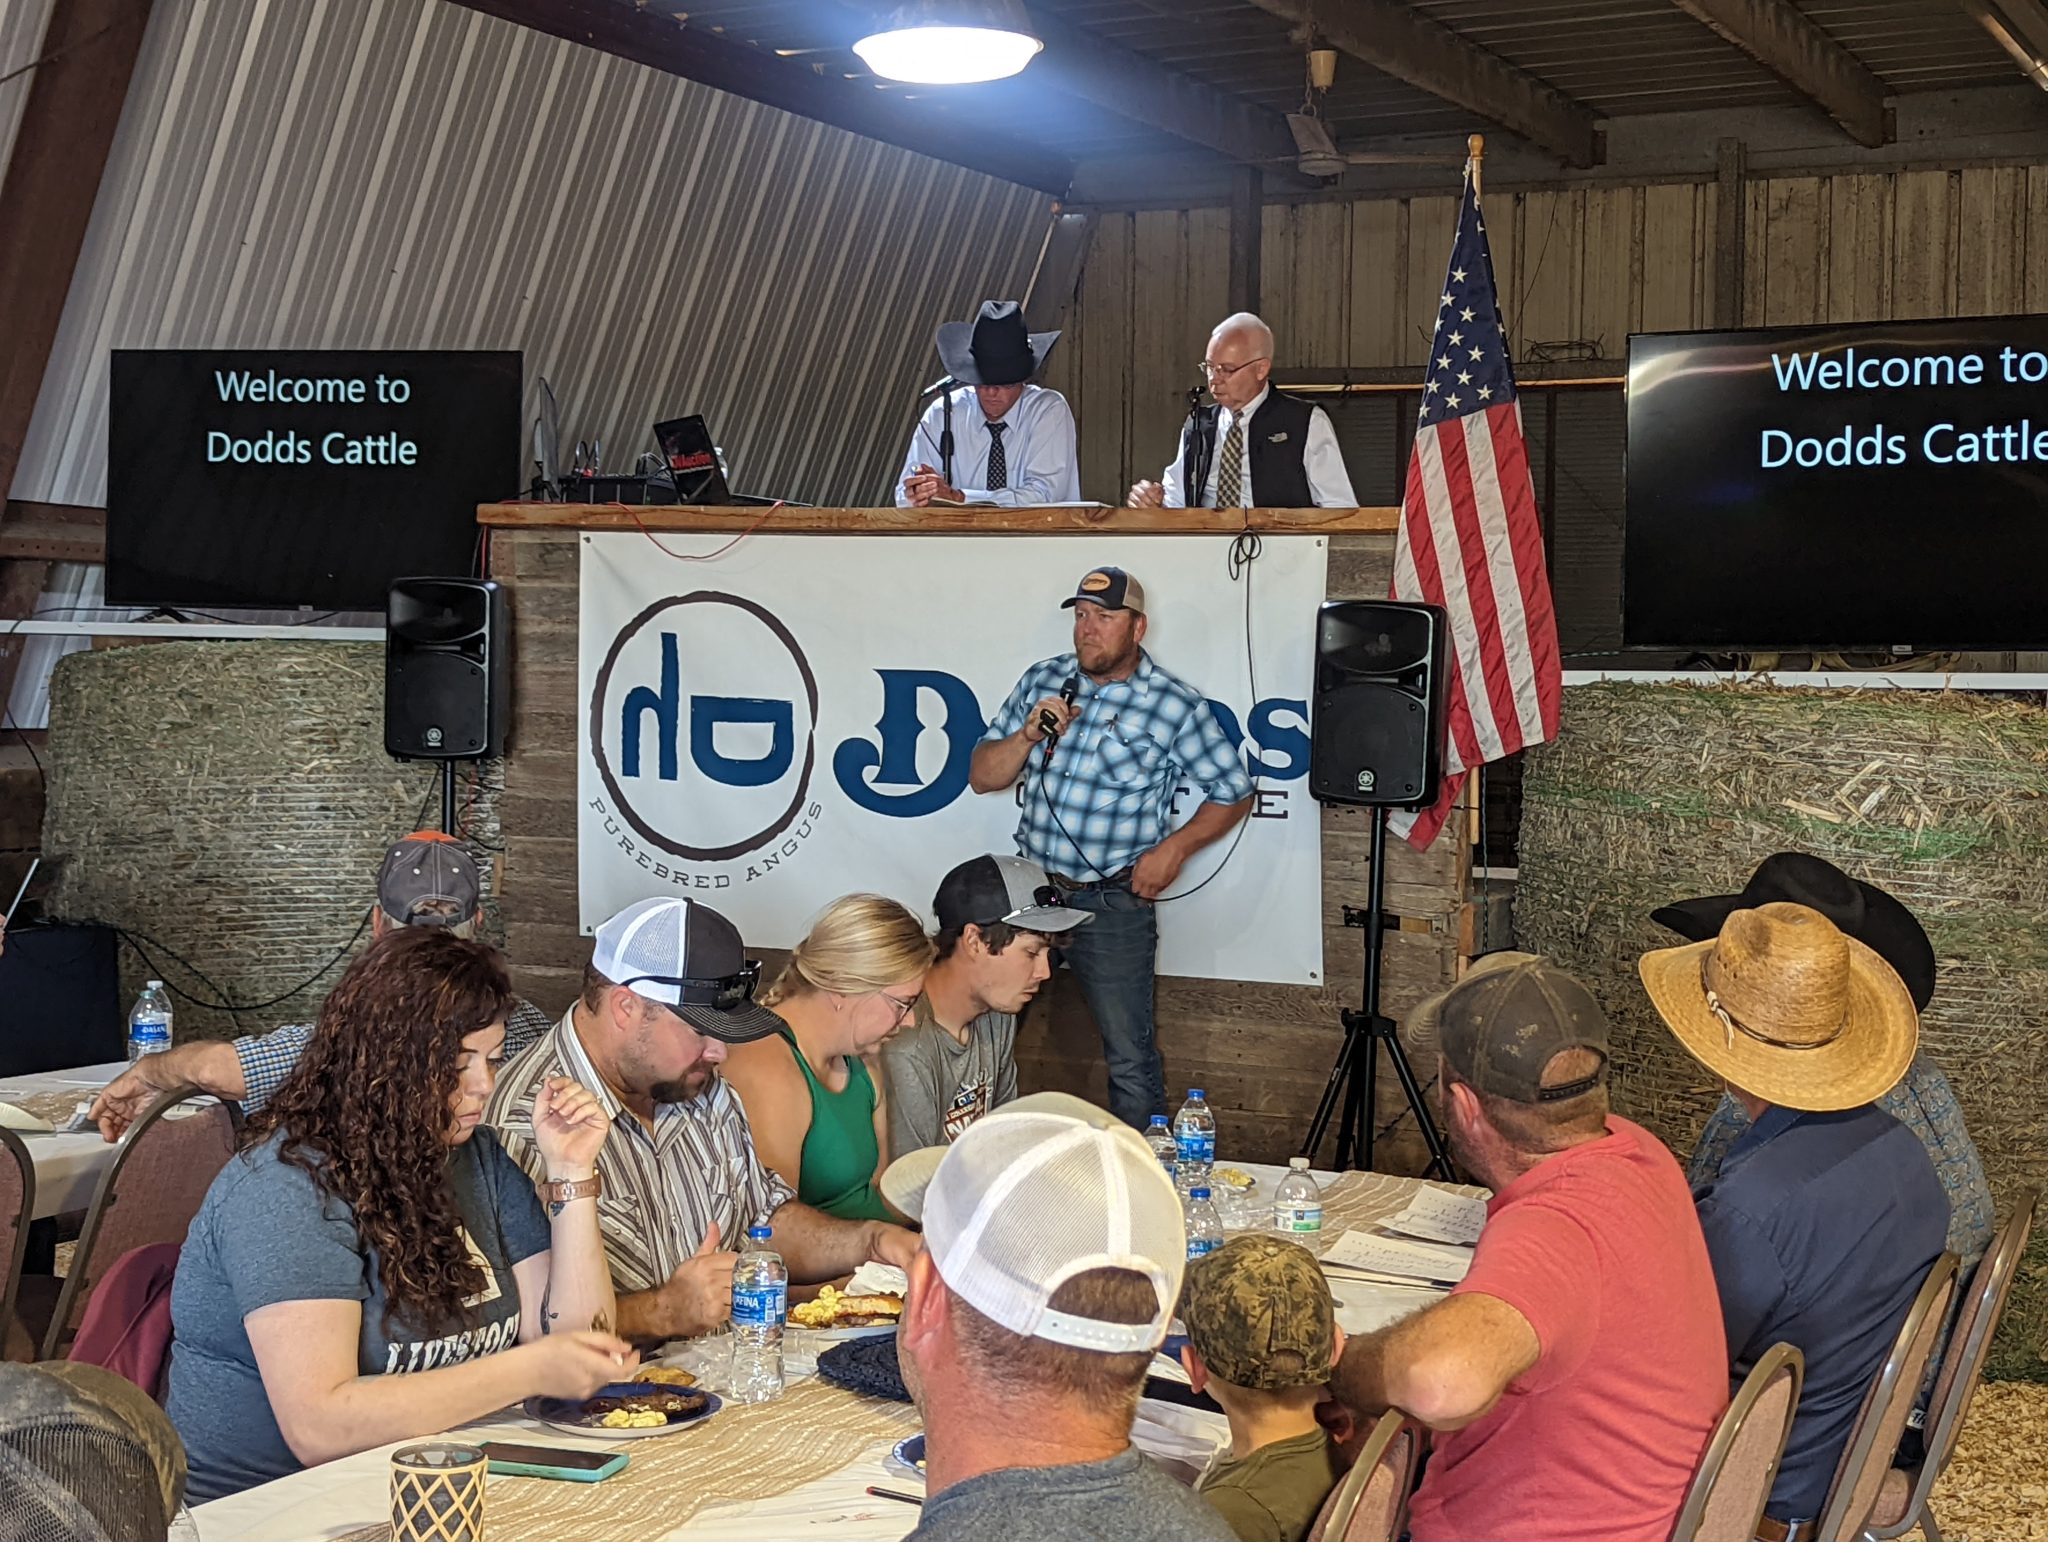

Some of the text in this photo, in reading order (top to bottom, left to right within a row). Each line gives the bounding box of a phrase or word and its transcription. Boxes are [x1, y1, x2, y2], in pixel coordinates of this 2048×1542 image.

[215, 369, 411, 403] Welcome to
[1771, 346, 2048, 391] Welcome to
[207, 430, 418, 466] Dodds Cattle
[1761, 423, 1907, 468] Dodds
[588, 796, 823, 889] PUREBRED ANGUS
